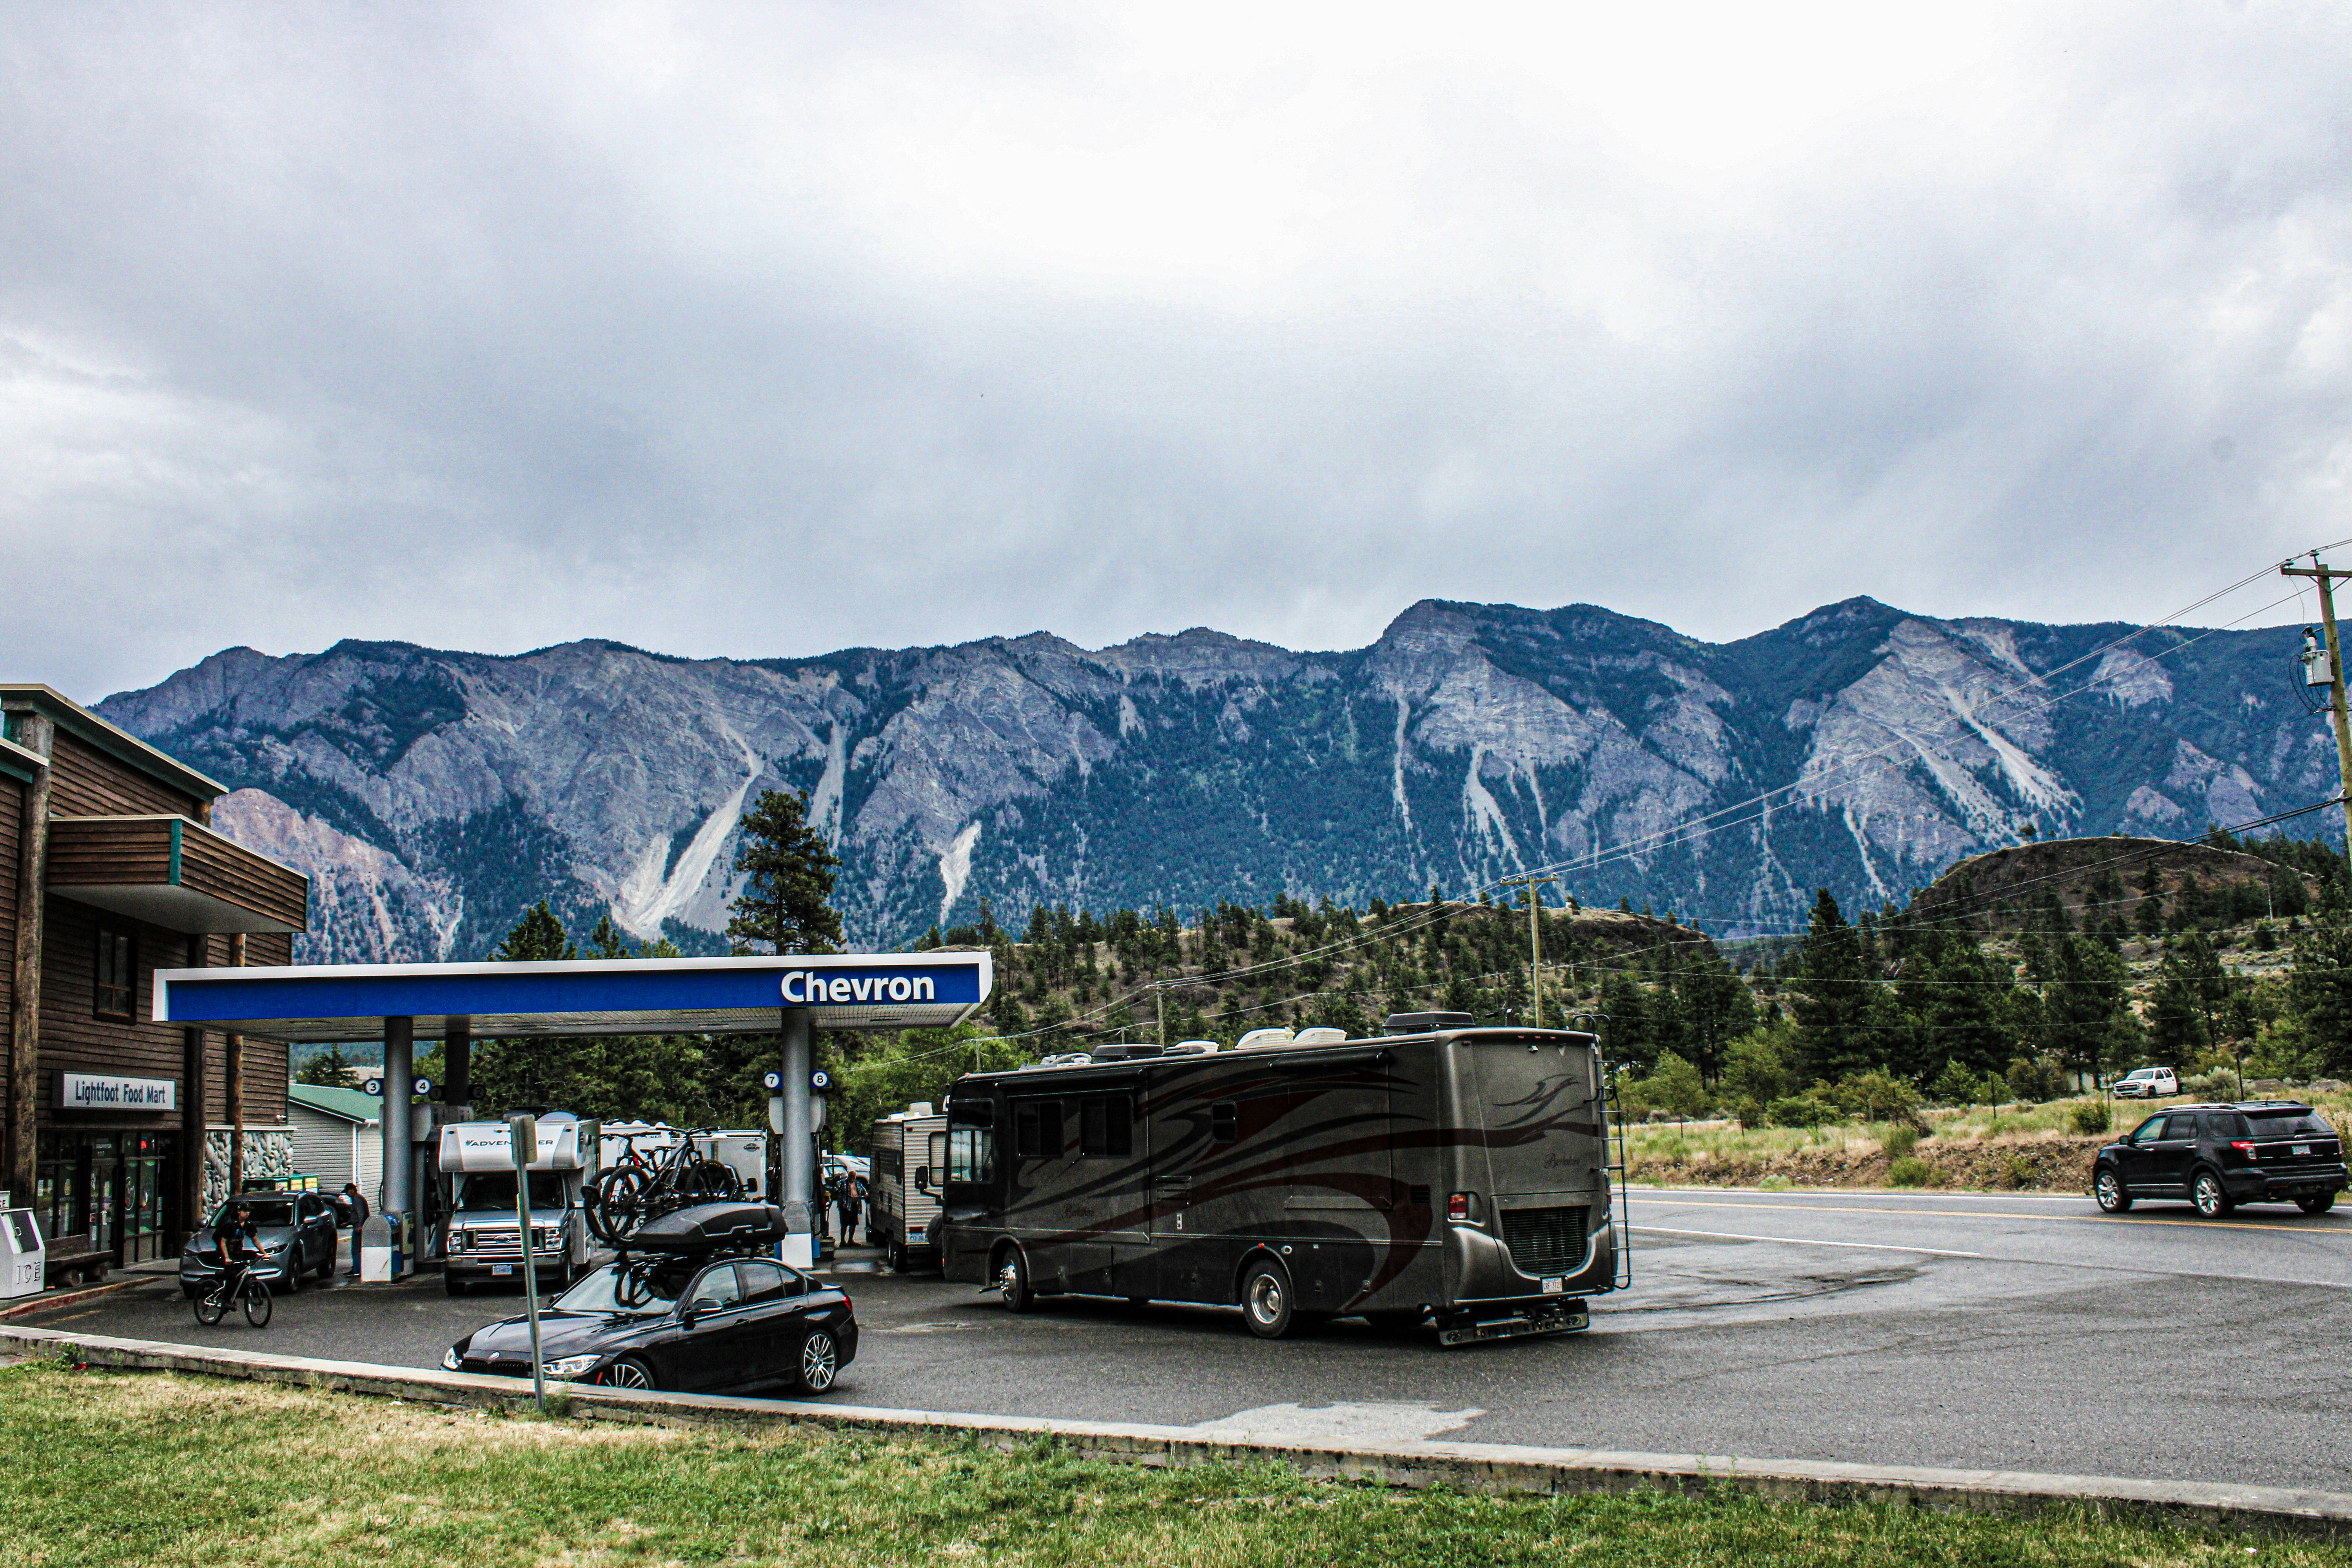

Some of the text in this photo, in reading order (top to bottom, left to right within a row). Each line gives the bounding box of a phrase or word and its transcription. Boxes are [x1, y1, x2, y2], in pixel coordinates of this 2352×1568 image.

[781, 971, 934, 1002] Chevron
[76, 1080, 165, 1105] Lightfoot Food Mart
[370, 1083, 376, 1091] 3
[16, 1261, 41, 1285] ICE
